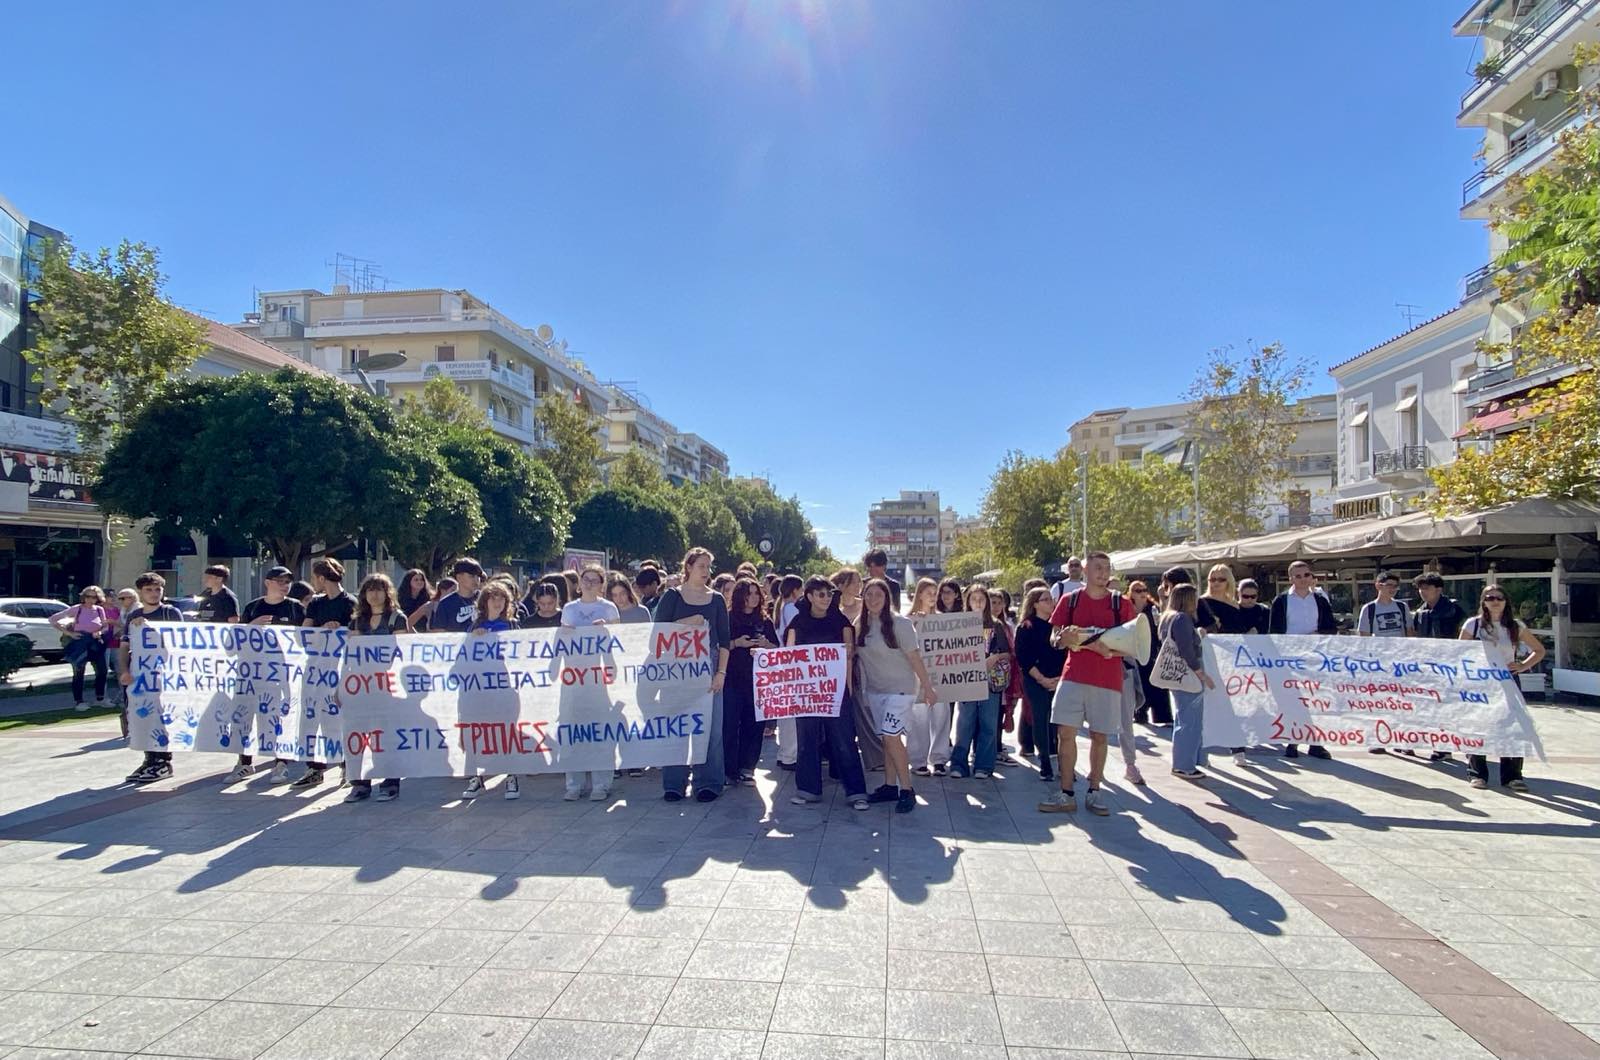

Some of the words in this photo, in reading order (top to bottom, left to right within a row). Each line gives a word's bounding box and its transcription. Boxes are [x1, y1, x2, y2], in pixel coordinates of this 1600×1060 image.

[345, 645, 361, 666] Η
[365, 646, 404, 664] ΝΕΑ
[410, 642, 468, 663] ΓΕΝΙΑ
[472, 641, 519, 662] ΕΧΕΙ
[527, 635, 626, 659] ΙΔΑΝΙΚΑ
[655, 629, 709, 660] ΜΣΚ
[813, 646, 840, 662] ΚΑΛΑ
[139, 655, 173, 670] ΚΑΙ
[178, 656, 262, 679] ΕΛΕΓΧΟΙ
[265, 661, 303, 682] ΣΤΑ
[345, 672, 397, 695] ΟΥΤΕ
[406, 672, 551, 693] ΞΕΠΟΥΛΙΕΤΑΙ
[560, 665, 616, 686] ΟΥΤΕ
[624, 661, 711, 684] ΠΡΟΣΚΥΝΑ
[808, 664, 828, 679] ΚΑΙ
[1313, 650, 1386, 678] λεφτά
[1392, 661, 1422, 677] για
[1424, 662, 1458, 685] την
[195, 675, 255, 696] ΚΤΗΡΙΑ
[757, 682, 818, 699] ΚΑΘΗΓΗΤΕΣ
[819, 678, 838, 693] ΚΑΙ
[1225, 672, 1269, 697] ΟΧΙ
[1283, 679, 1321, 696] στην
[1459, 690, 1489, 705] και
[1298, 696, 1331, 713] την
[347, 730, 385, 755] ΟΧΙ
[396, 728, 449, 750] ΣΤΙΣ
[454, 721, 553, 755] ΤΡΙΠΛΕΣ
[557, 713, 705, 745] ΠΑΝΕΛΛΑΔΙΚΕΣ
[1269, 713, 1365, 746] Σύλλογος
[1375, 719, 1485, 750] Οικοτρόφων
